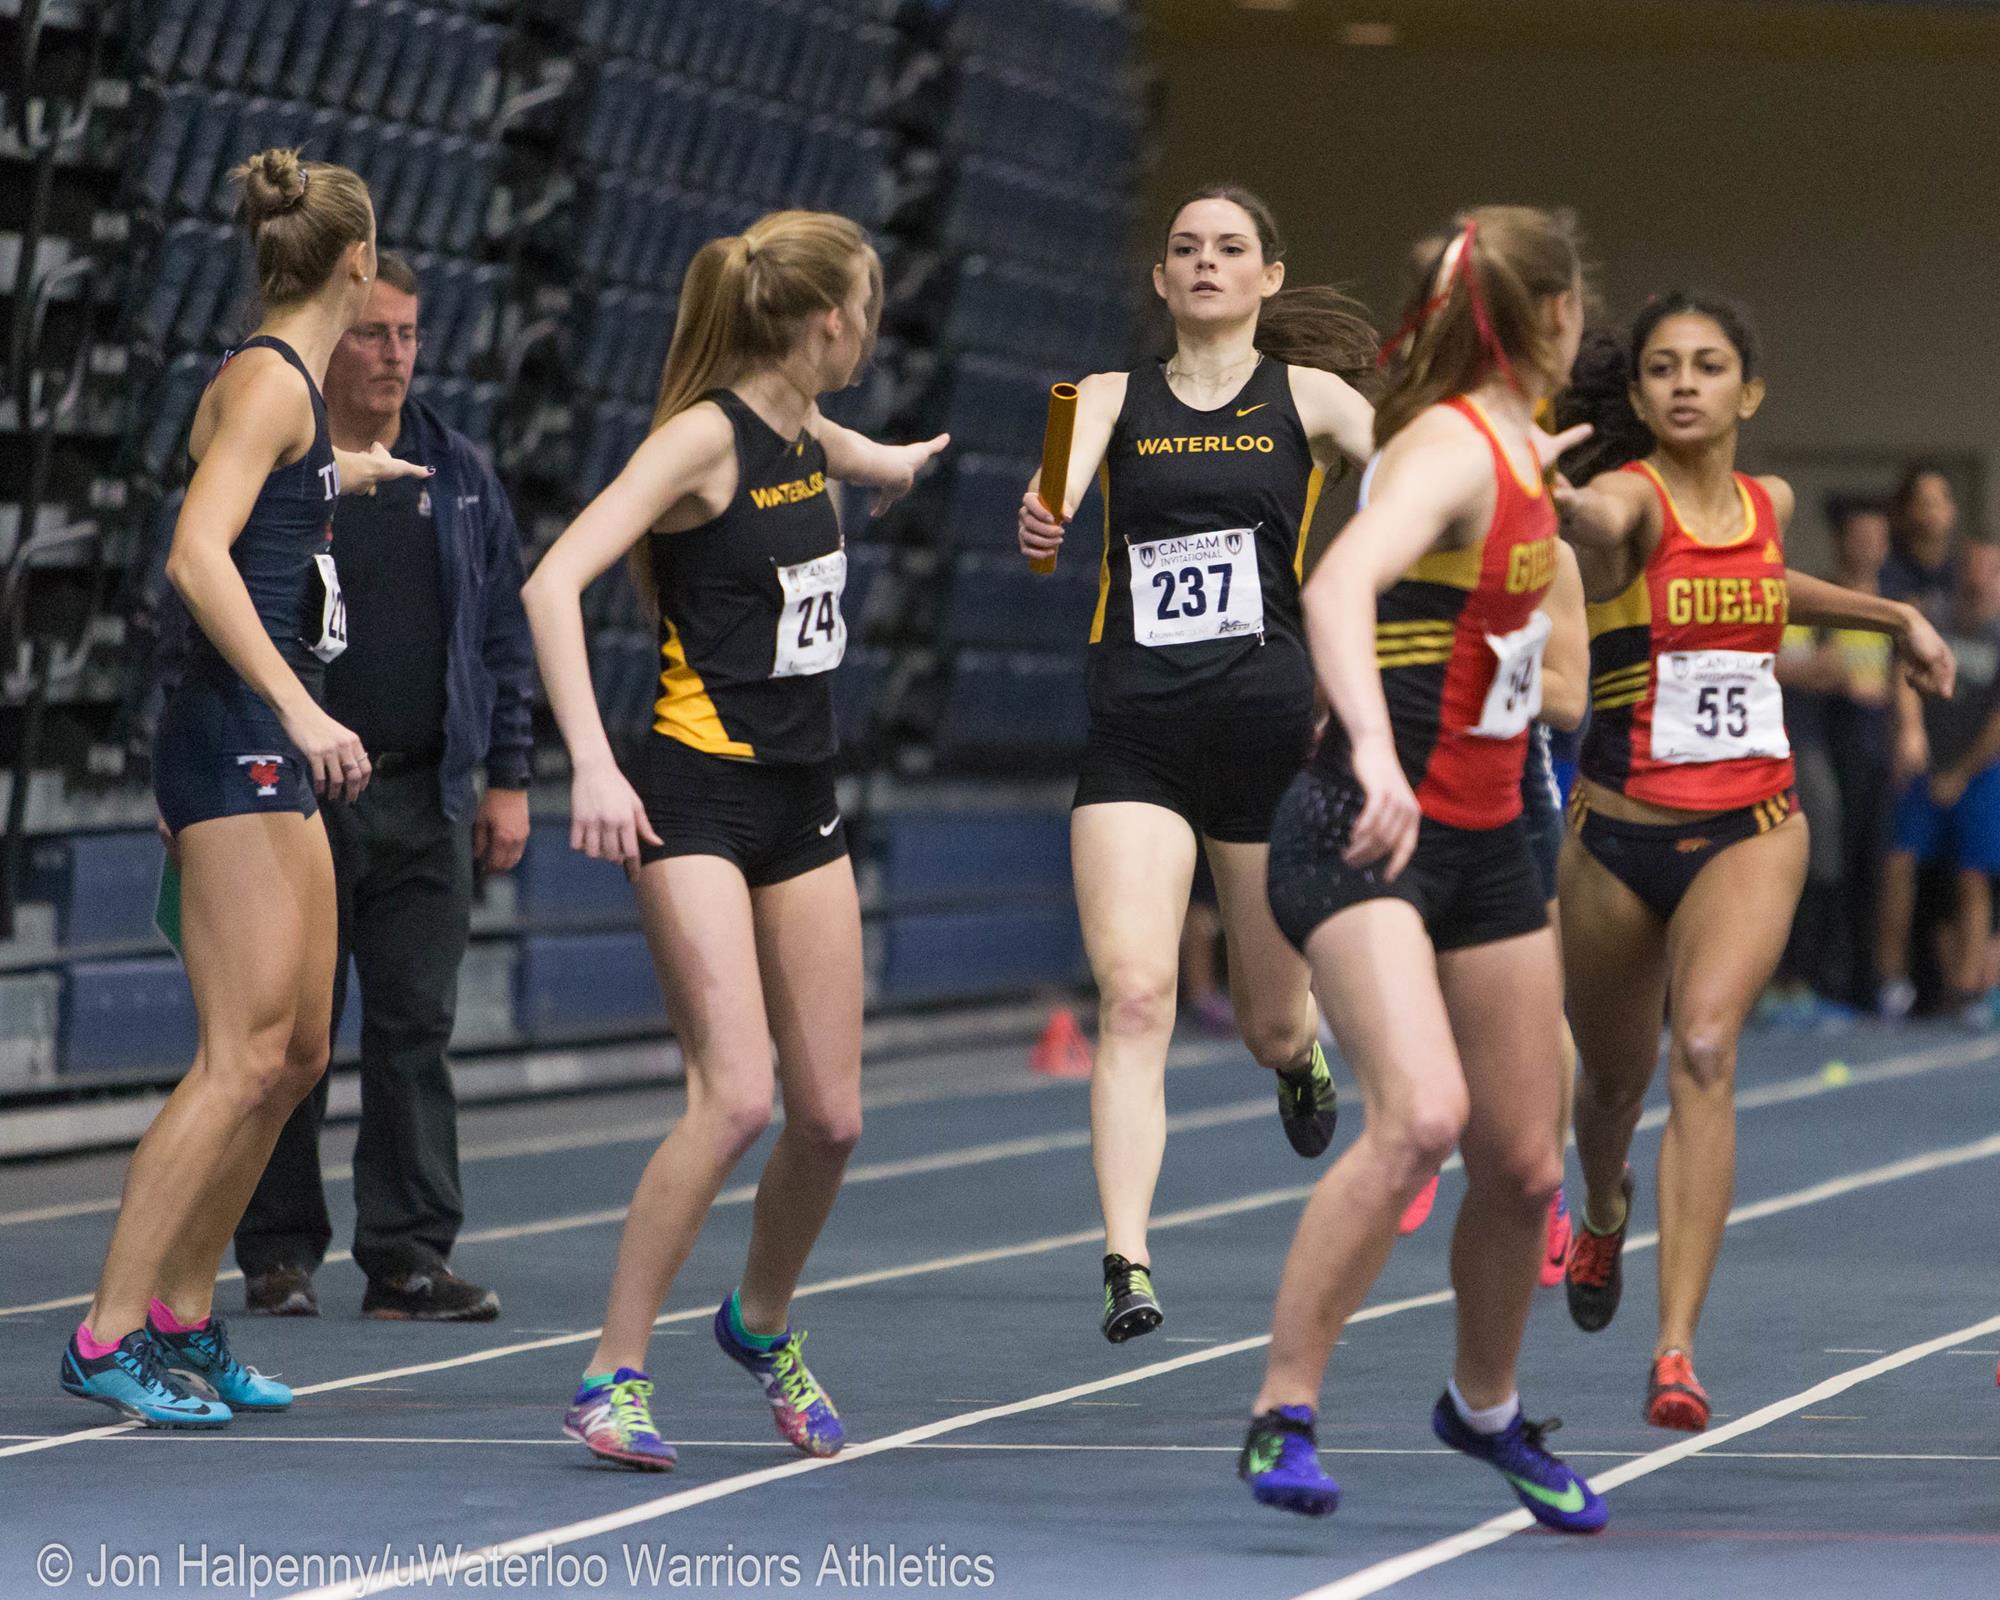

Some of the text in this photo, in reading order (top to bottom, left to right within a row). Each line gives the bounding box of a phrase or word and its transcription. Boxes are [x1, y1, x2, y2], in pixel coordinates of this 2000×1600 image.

[1137, 435, 1275, 456] WATERLOO
[1158, 535, 1220, 556] CAN-AM
[1159, 550, 1224, 568] INVITATIONAL
[1151, 562, 1233, 621] 237
[797, 591, 835, 649] 24
[1696, 687, 1748, 738] 55
